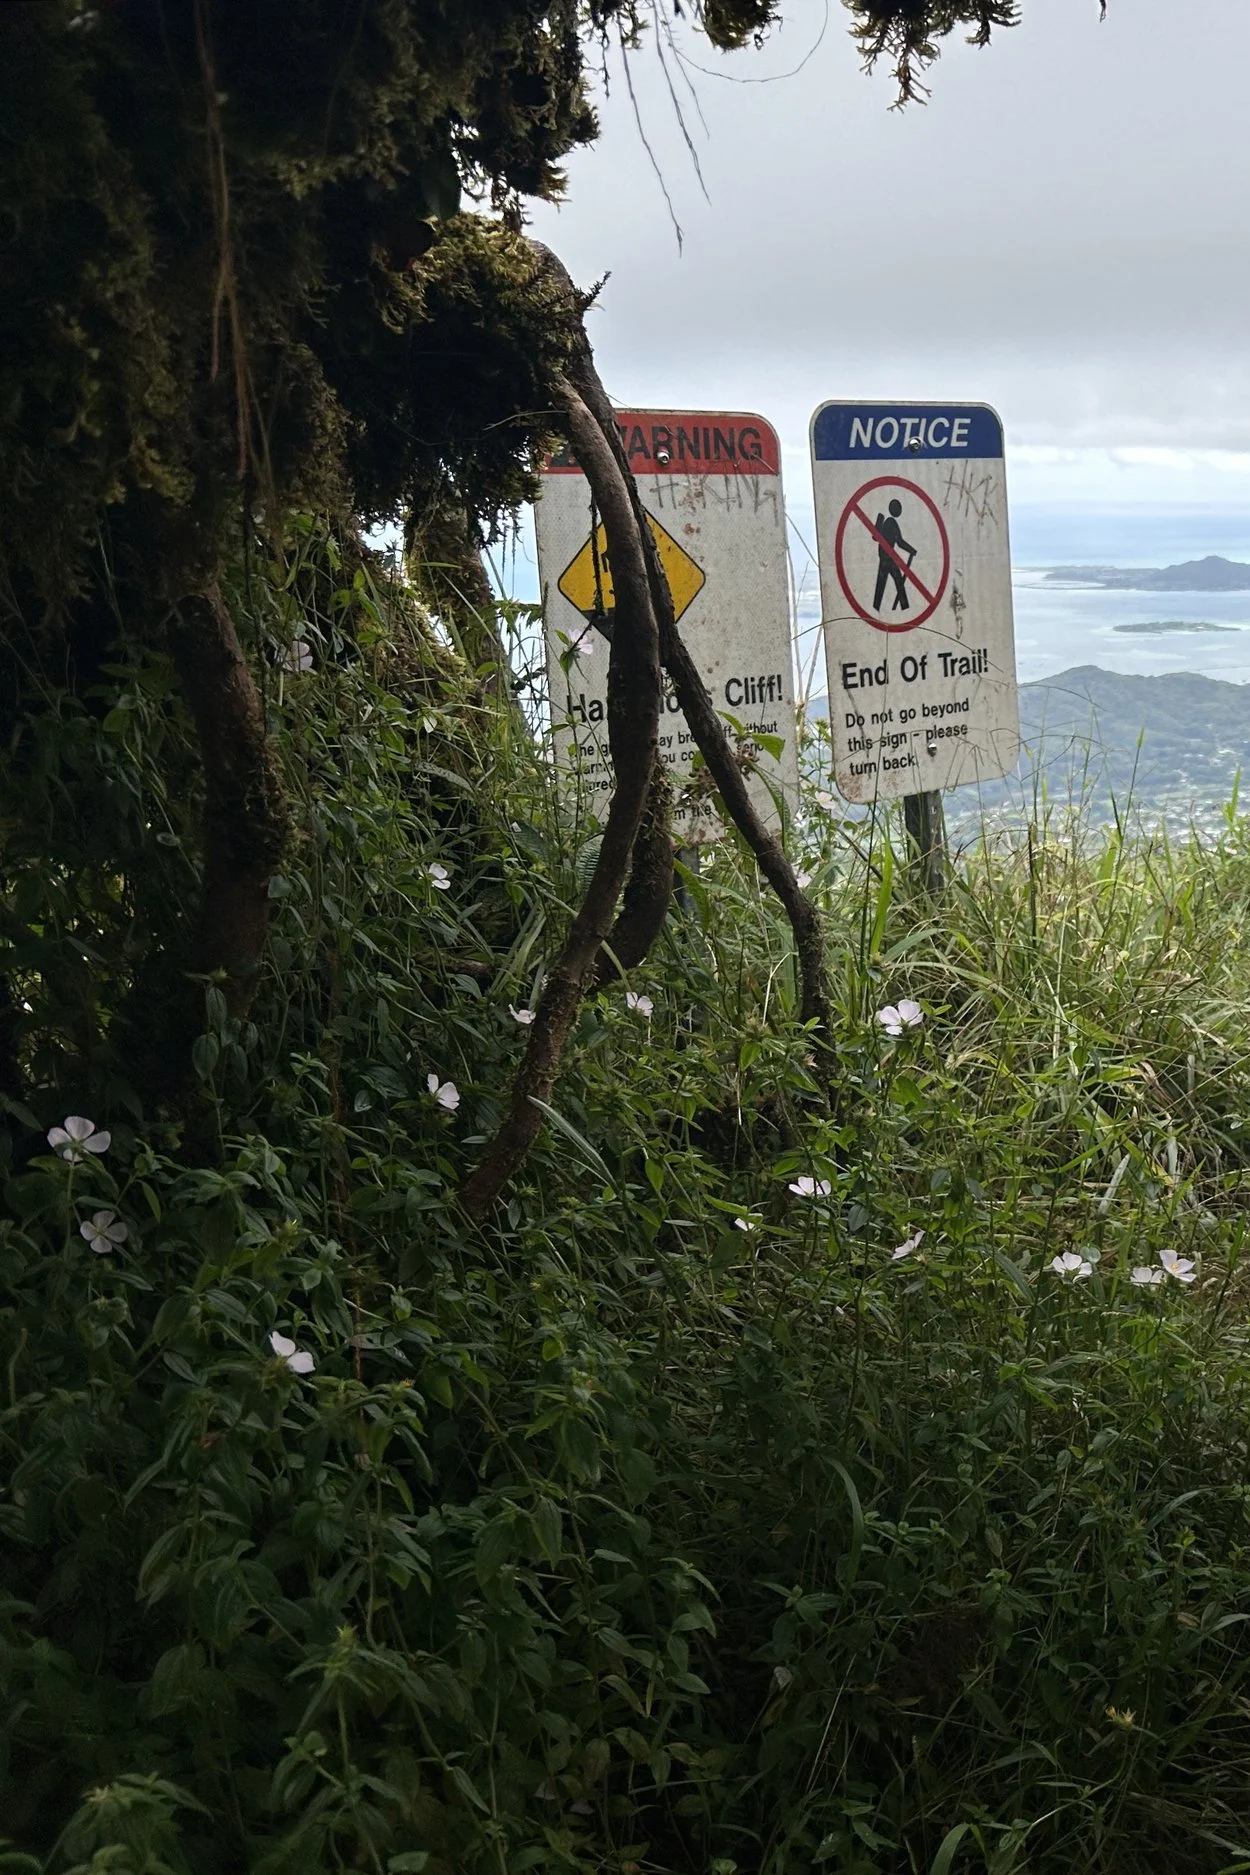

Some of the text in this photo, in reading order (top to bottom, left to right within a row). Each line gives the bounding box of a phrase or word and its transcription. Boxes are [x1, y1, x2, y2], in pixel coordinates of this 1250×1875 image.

[621, 424, 763, 461] ARNING
[849, 416, 971, 449] NOTICE
[842, 648, 989, 690] End Of Trail!
[724, 673, 783, 707] Cliff!
[845, 698, 970, 729] Do not go beyond
[659, 735, 673, 749] ay
[847, 736, 873, 752] this
[880, 730, 908, 750] sign
[925, 722, 969, 742] please
[850, 760, 877, 776] turn
